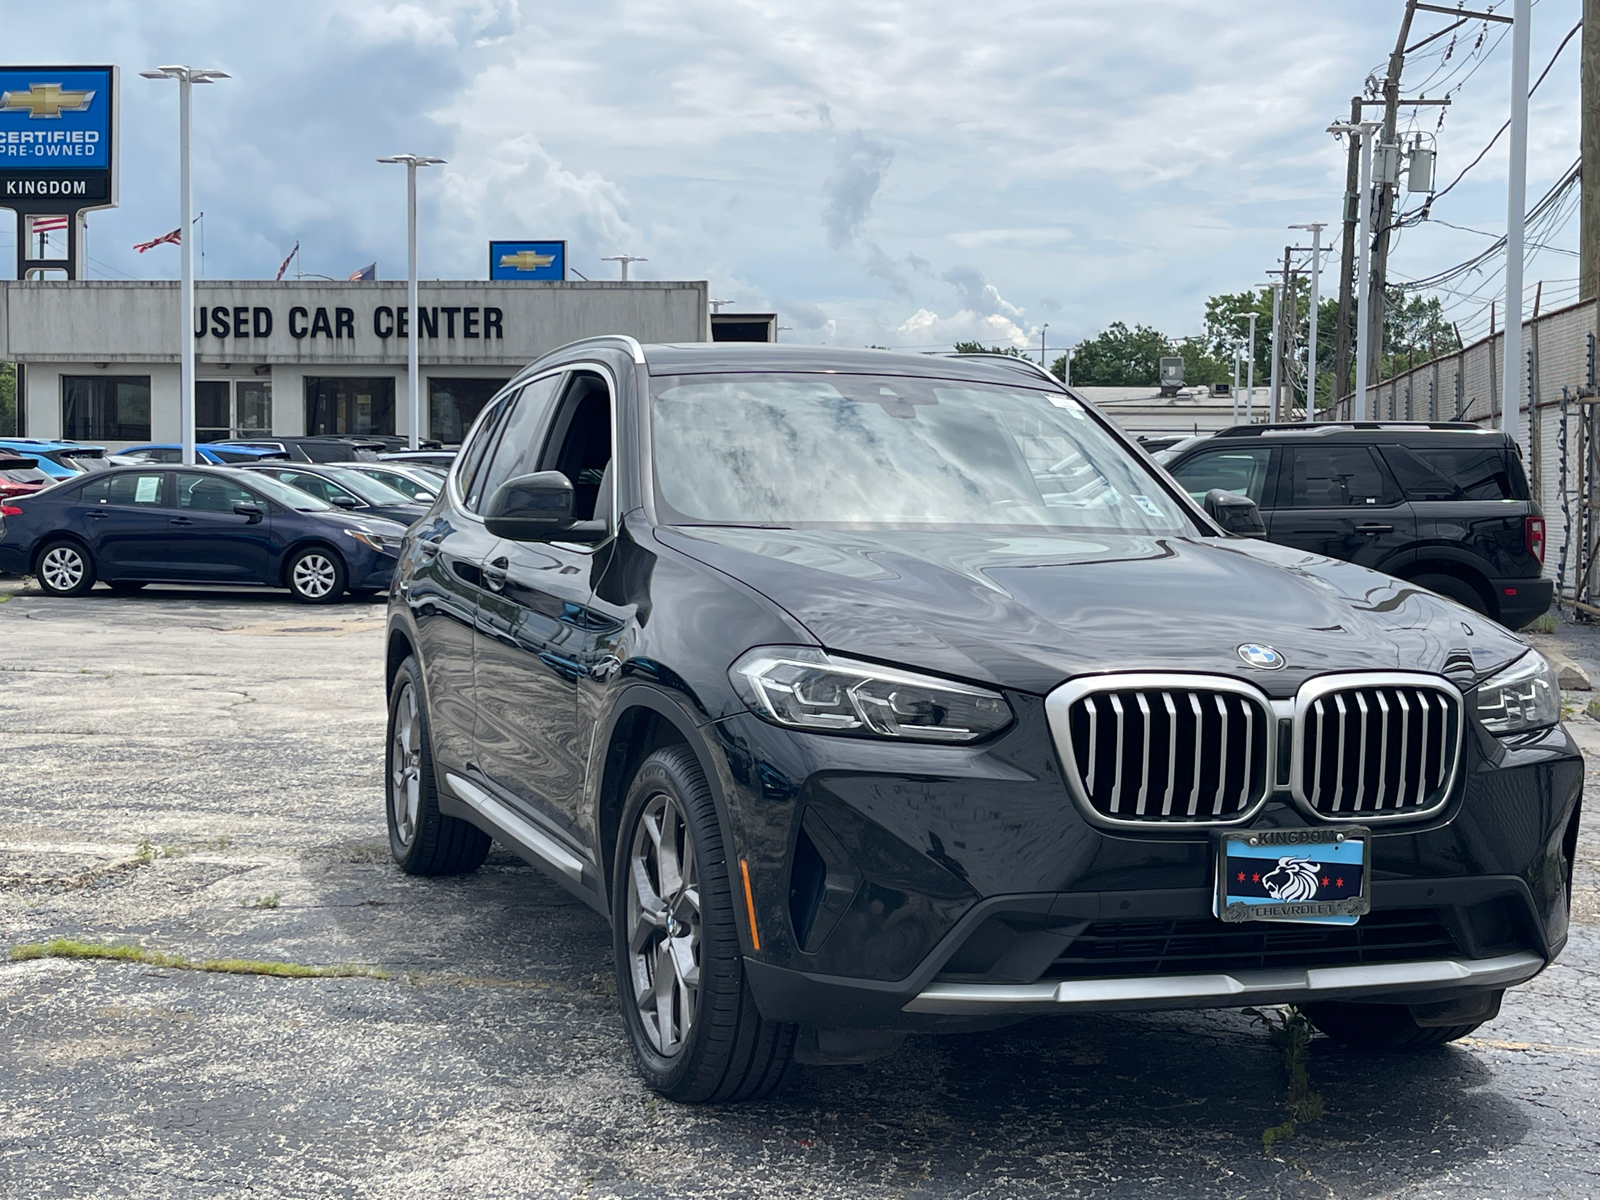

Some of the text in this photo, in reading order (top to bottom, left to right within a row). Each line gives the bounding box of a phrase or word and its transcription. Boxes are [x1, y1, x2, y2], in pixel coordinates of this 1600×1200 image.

[0, 144, 95, 156] PRE-OWNED
[6, 181, 86, 194] KINGDOM
[194, 305, 504, 339] USED CAR CENTER
[1258, 830, 1335, 845] KINGDOM
[1255, 904, 1333, 917] CHEVROLET
